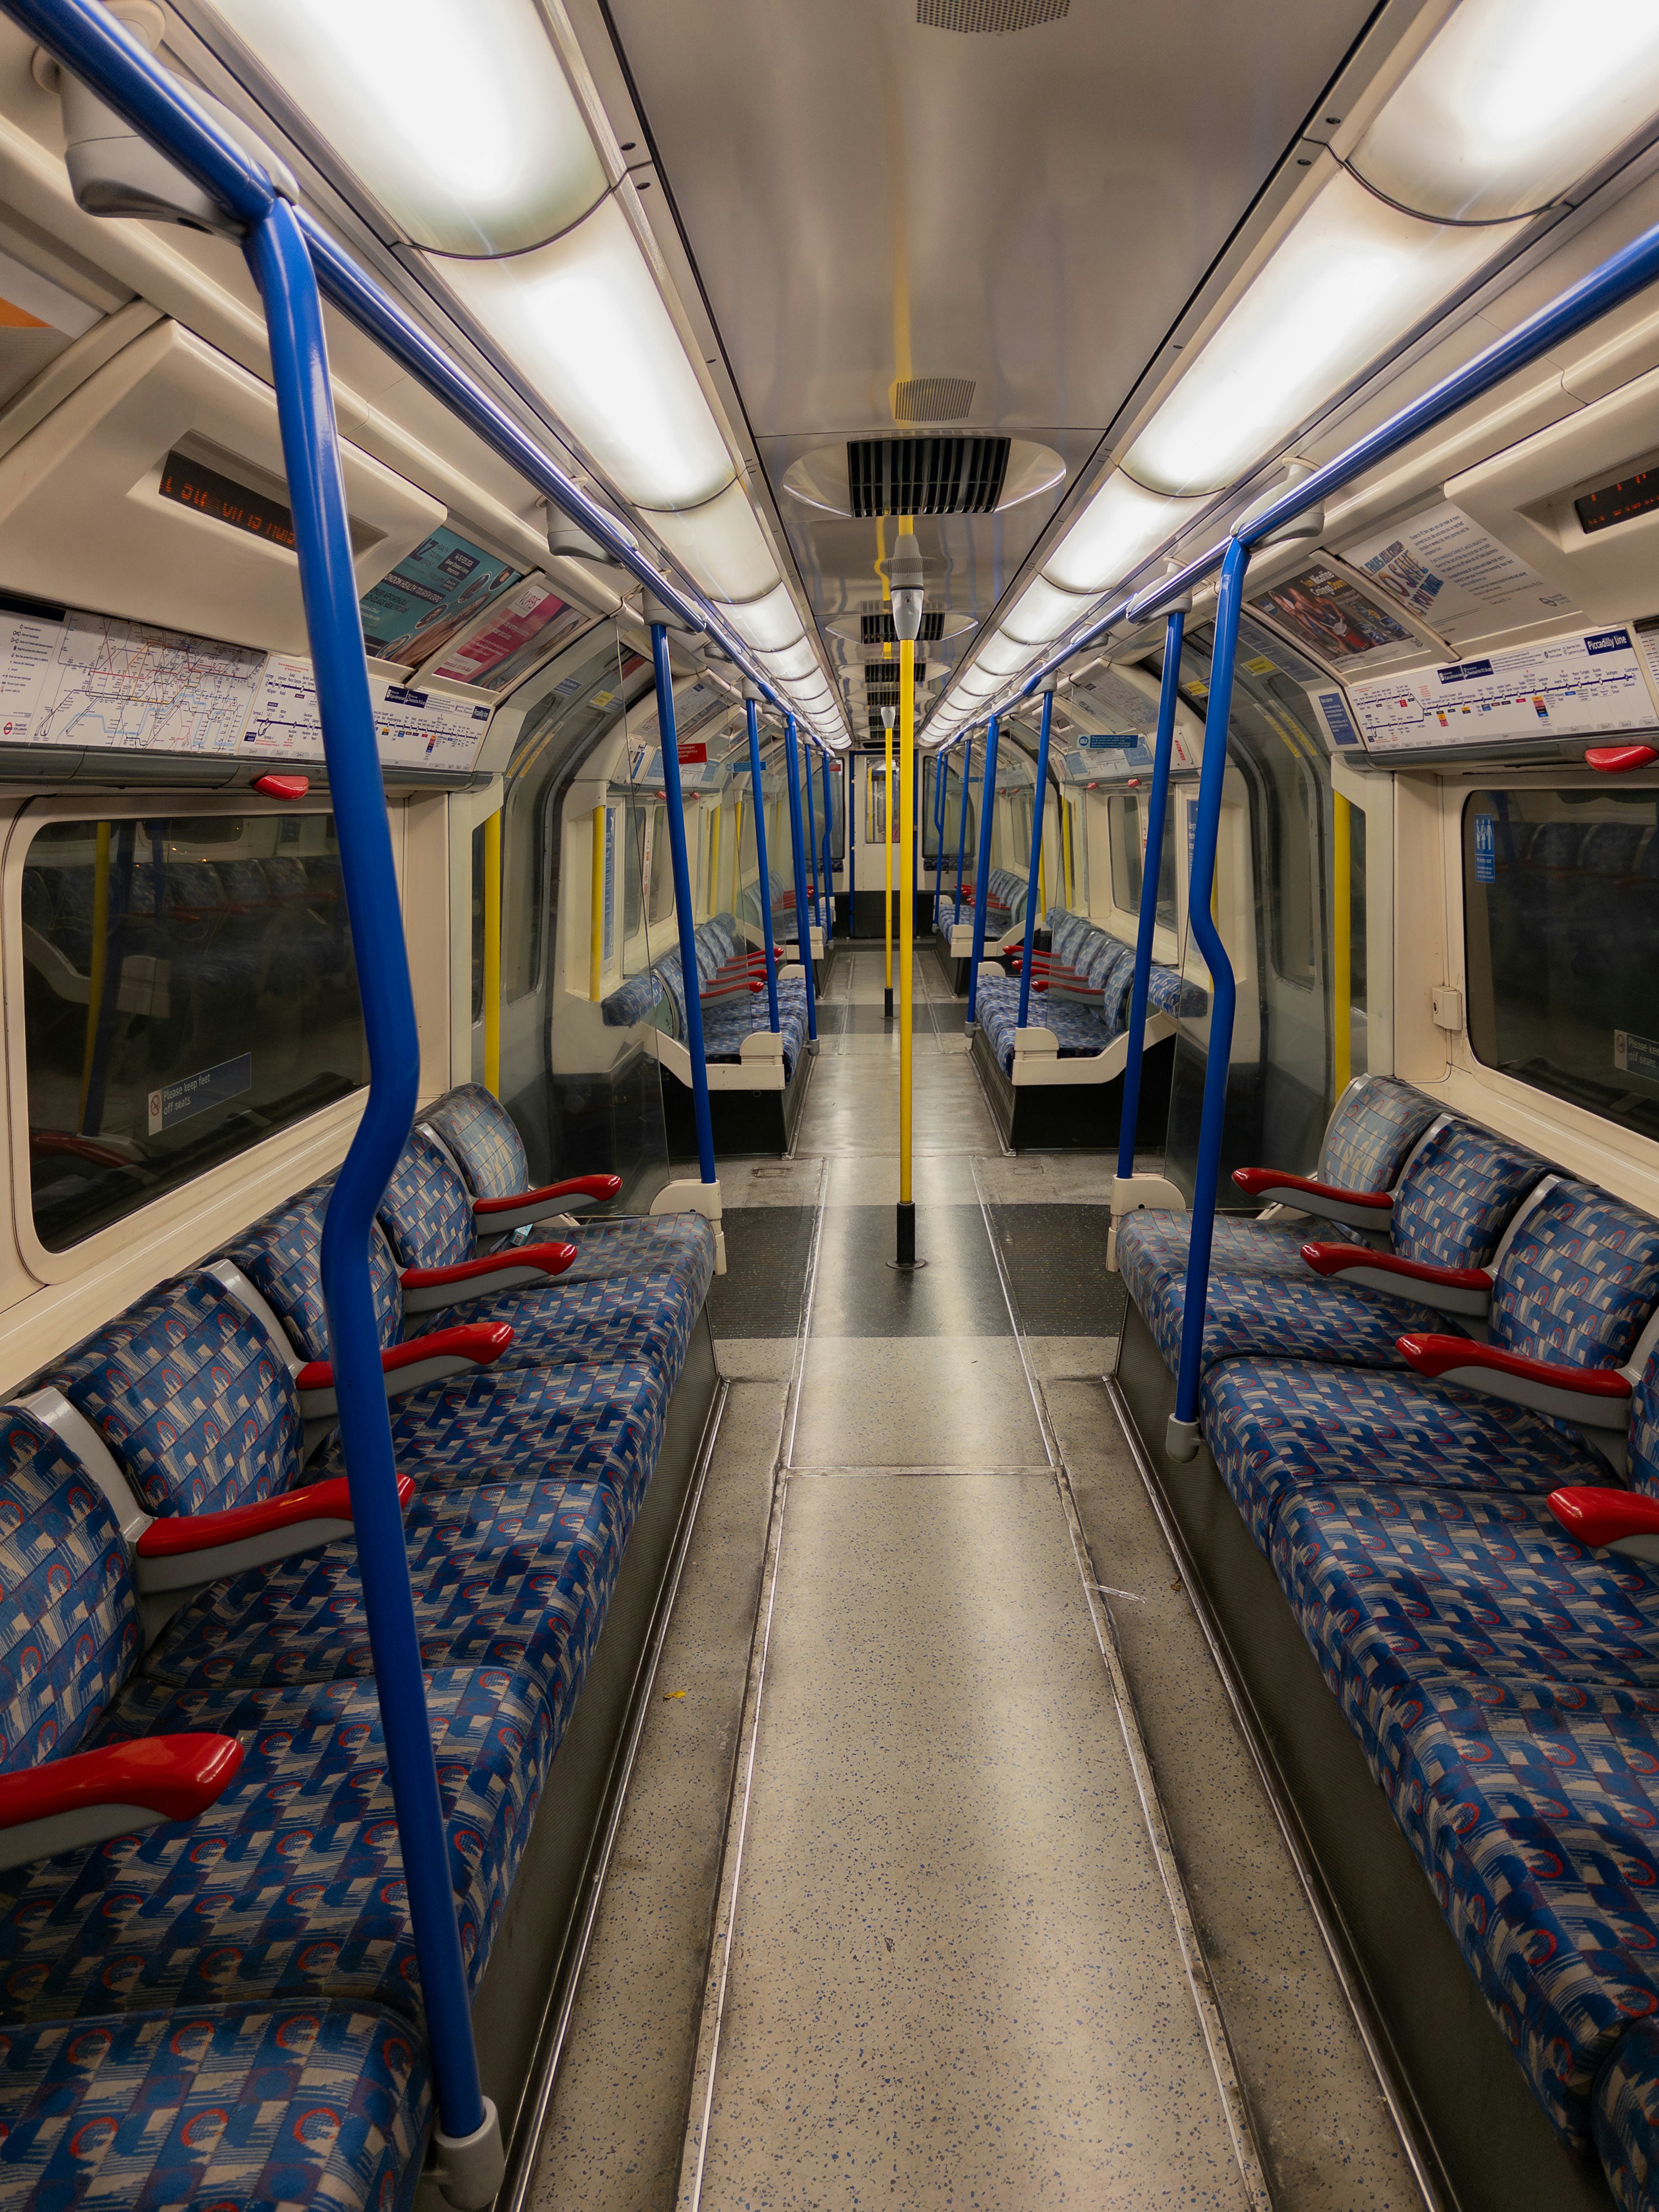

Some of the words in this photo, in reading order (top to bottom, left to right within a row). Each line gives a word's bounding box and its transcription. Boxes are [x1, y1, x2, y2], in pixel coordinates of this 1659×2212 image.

[400, 580, 418, 592] HEALTH
[1309, 571, 1335, 585] Nicotine
[1587, 637, 1614, 651] Piccadilly
[1613, 635, 1627, 645] line
[1628, 1037, 1647, 1052] Please
[1628, 1052, 1638, 1062] off
[1639, 1056, 1657, 1068] seats
[163, 1086, 183, 1102] Please
[183, 1080, 198, 1092] keep
[198, 1073, 211, 1086] feet
[163, 1102, 174, 1115] off
[174, 1097, 191, 1109] seats
